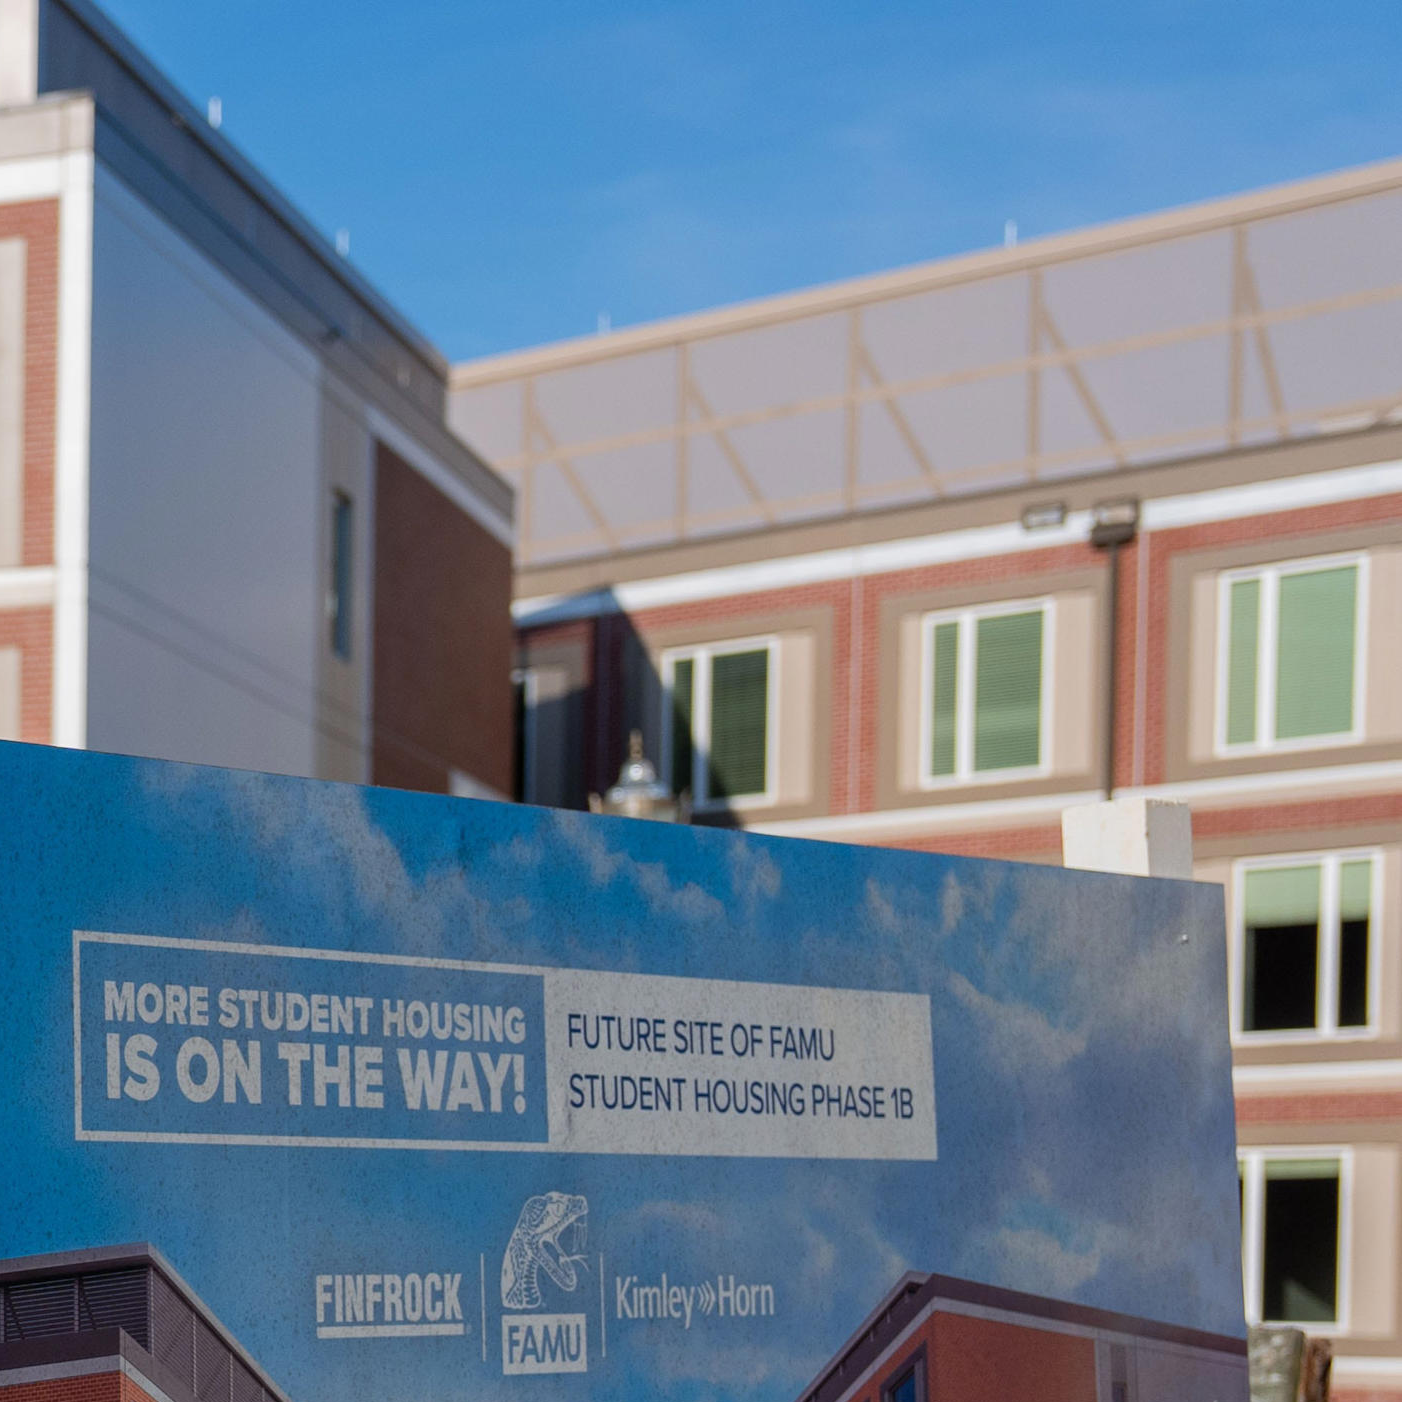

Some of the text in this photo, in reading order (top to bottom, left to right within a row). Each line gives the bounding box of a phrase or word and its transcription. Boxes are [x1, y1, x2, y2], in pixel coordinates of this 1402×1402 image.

[103, 980, 526, 1044] MORE STUDENT HOUSING
[568, 1014, 835, 1061] FUTURE SITE OF FAMU
[105, 1032, 527, 1114] IS ON THE WAY!
[569, 1074, 914, 1119] STUDENT HOUSING PHASE 1B
[316, 1272, 463, 1323] FINFROCK
[615, 1274, 775, 1330] Kimley Horn
[507, 1323, 581, 1364] FAMU
